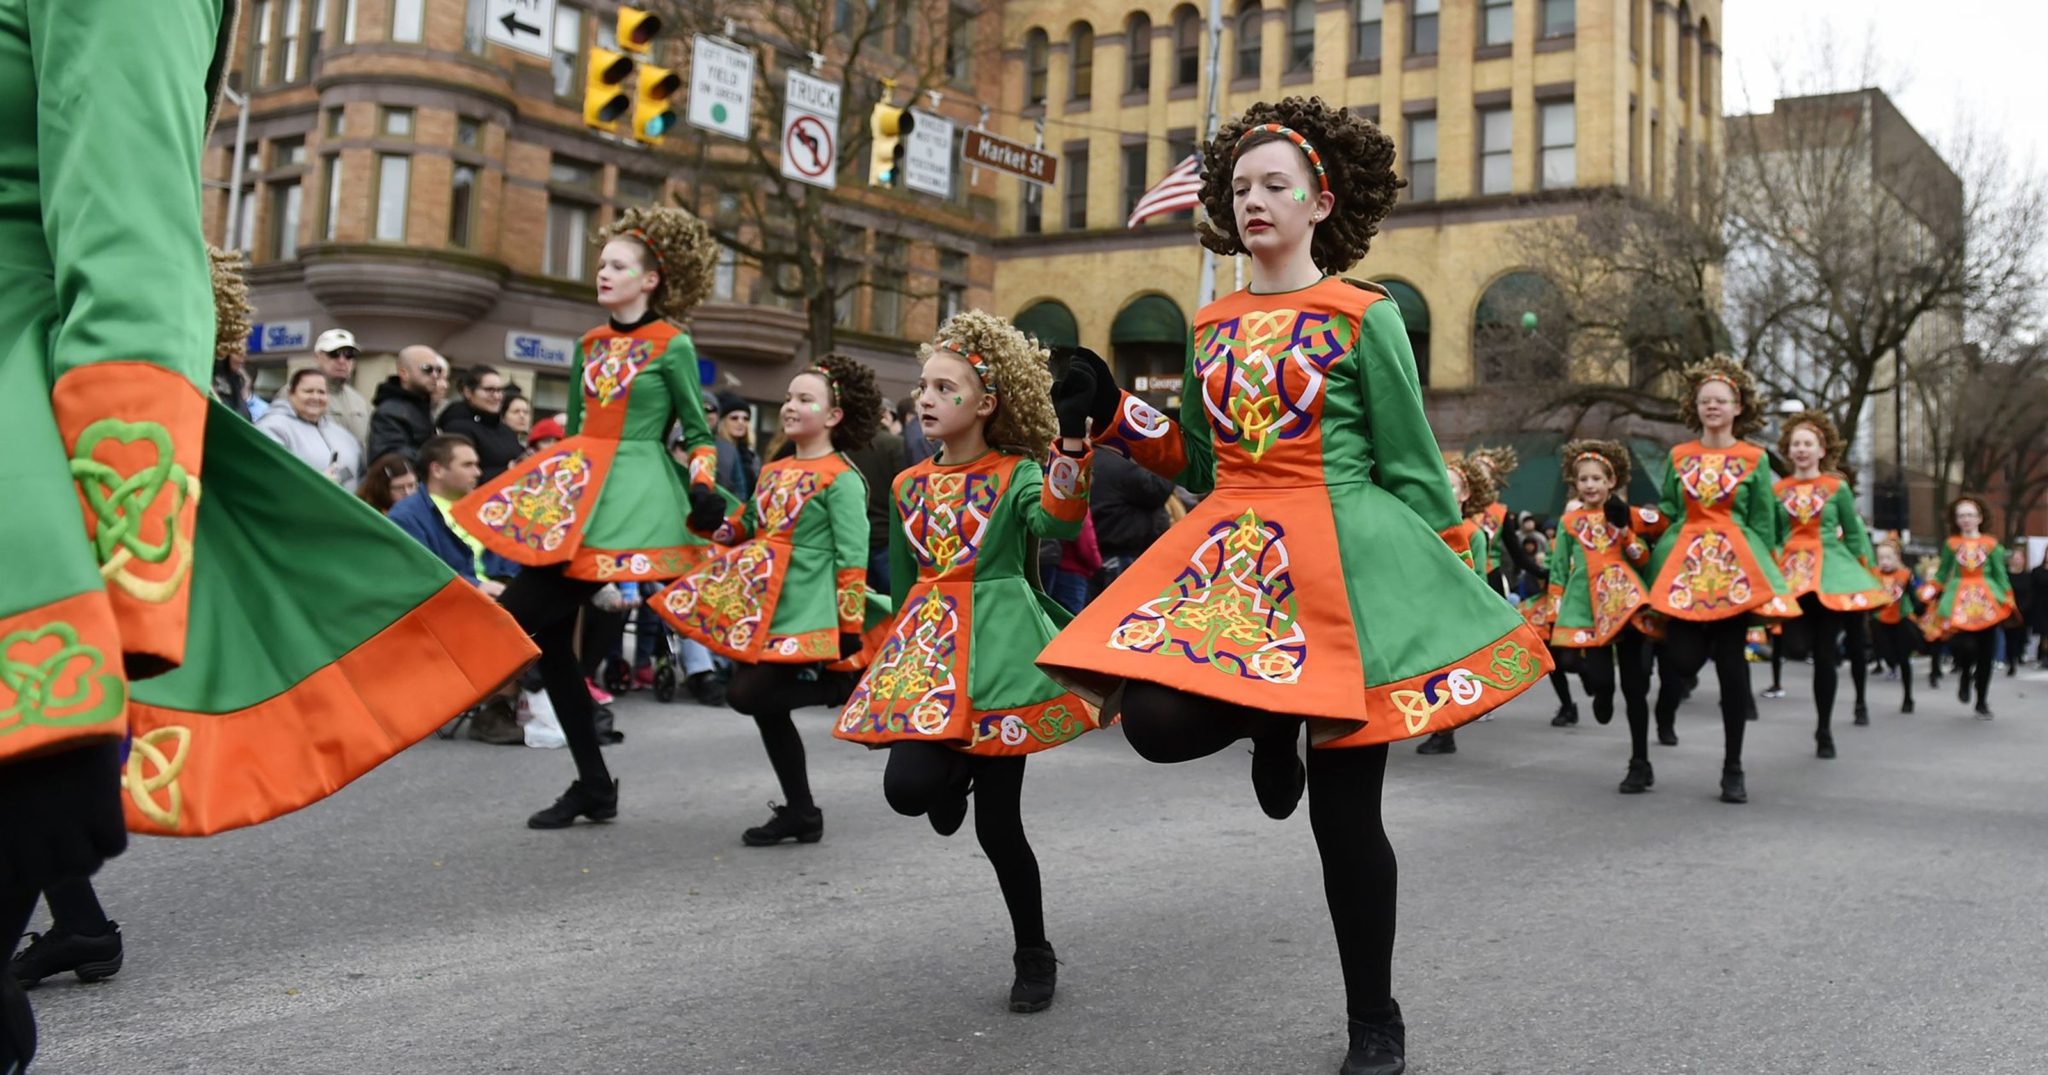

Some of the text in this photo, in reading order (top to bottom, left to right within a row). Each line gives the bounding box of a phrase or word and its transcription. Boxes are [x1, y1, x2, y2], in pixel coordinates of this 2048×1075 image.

[707, 64, 737, 85] YIELD
[791, 79, 836, 110] TRUCK
[979, 138, 1044, 176] Market St
